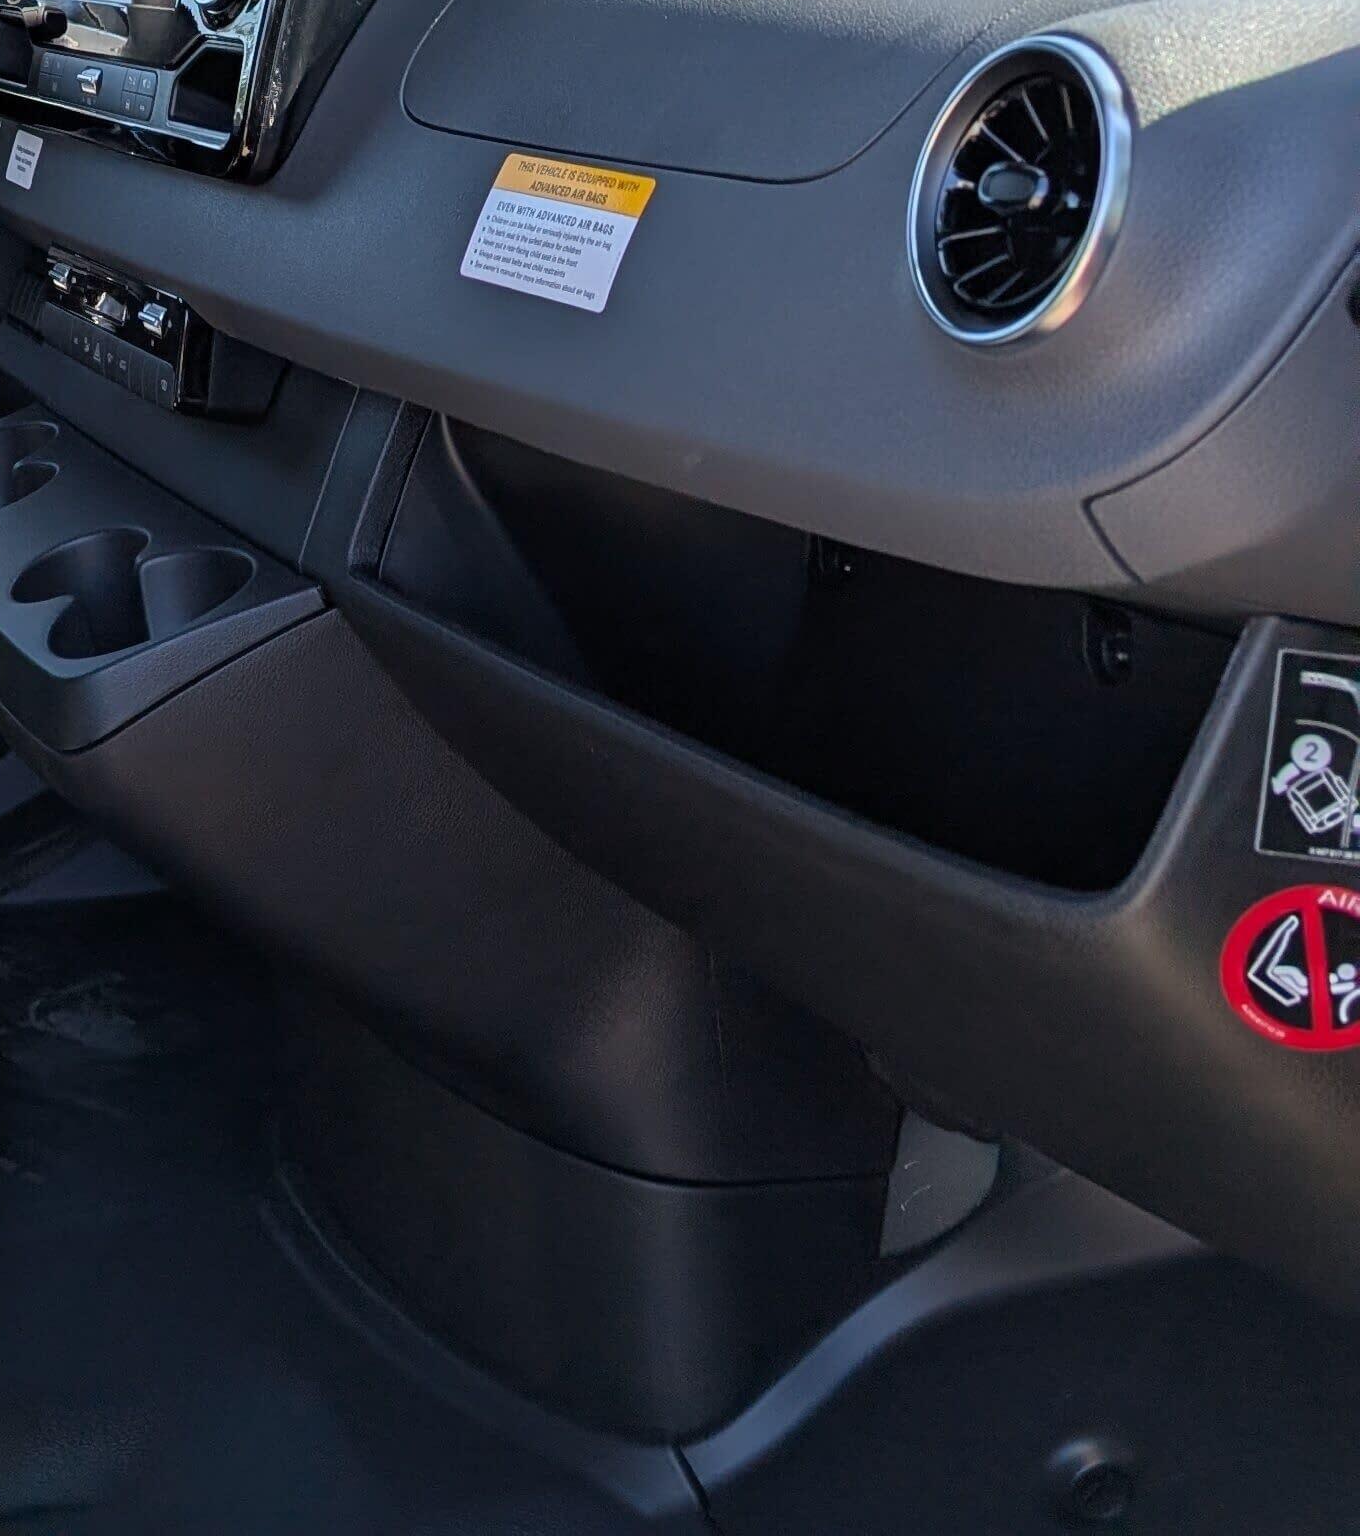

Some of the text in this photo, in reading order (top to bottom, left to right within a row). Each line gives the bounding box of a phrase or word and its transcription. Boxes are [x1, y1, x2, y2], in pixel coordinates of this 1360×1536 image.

[518, 160, 640, 192] THIS VEHICLE IS EQUIPPED WITH
[529, 180, 608, 204] ADVANCED AIR BAGS
[496, 201, 614, 235] EVEN WITH ADVANCED AIR BAGS
[1304, 742, 1320, 762] 2
